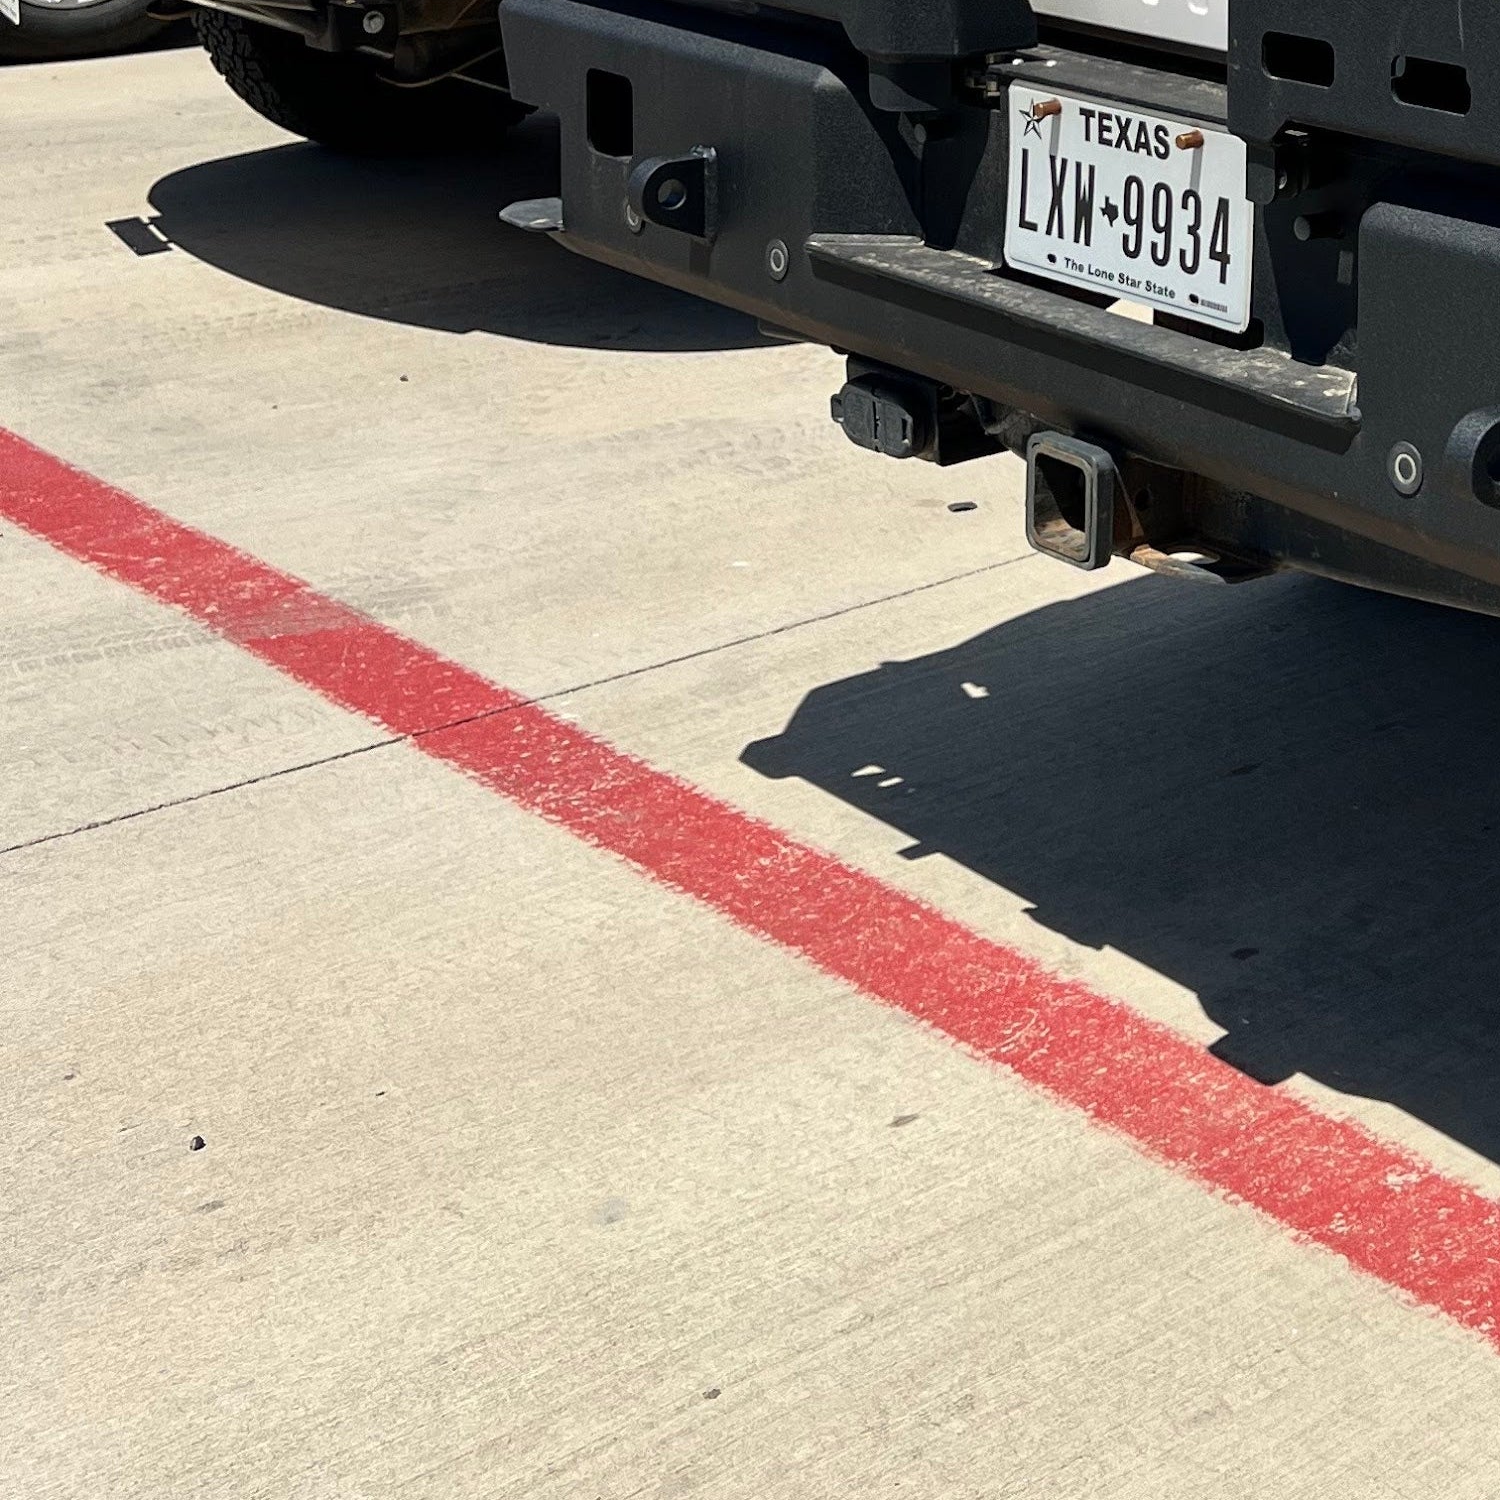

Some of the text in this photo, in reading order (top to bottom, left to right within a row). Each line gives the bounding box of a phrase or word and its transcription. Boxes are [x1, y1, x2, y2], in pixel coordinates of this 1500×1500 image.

[1078, 107, 1171, 160] TEXAS
[1063, 256, 1176, 299] The Lone Star State
